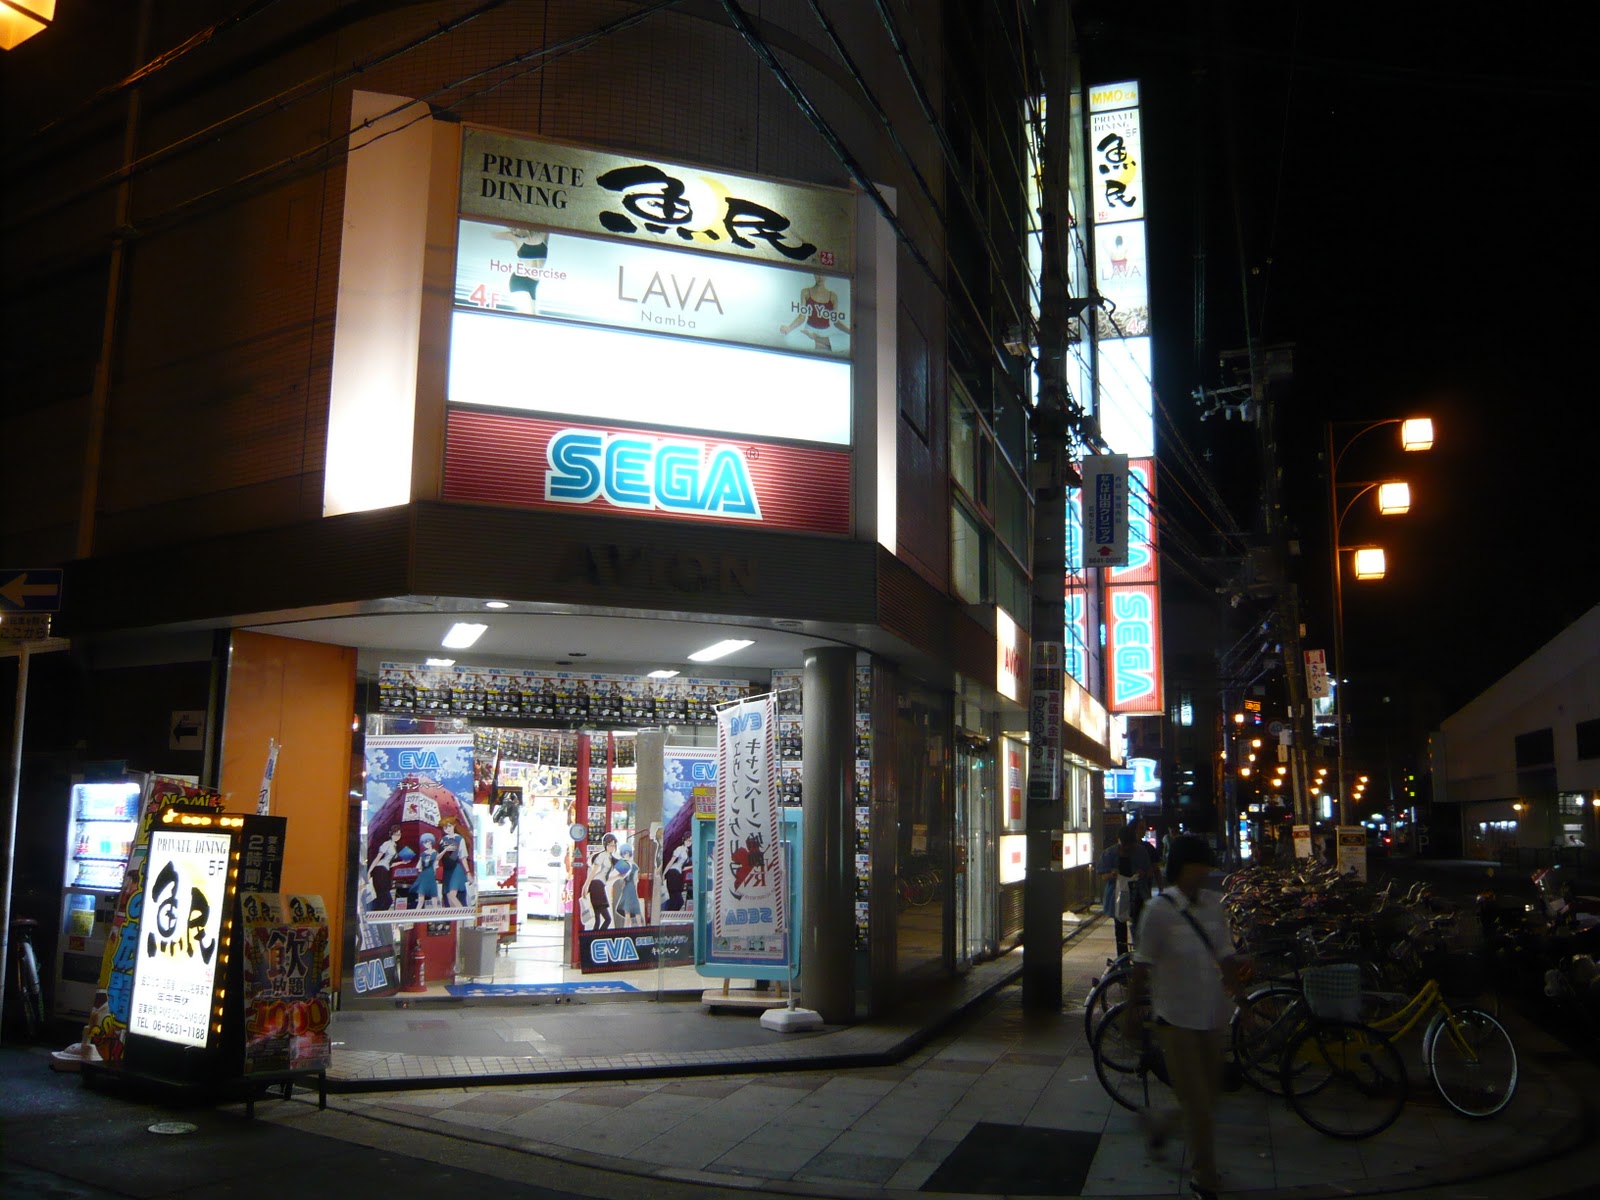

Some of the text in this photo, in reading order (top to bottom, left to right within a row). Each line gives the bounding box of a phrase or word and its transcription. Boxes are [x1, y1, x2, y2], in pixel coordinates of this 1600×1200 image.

[1094, 112, 1135, 124] PRIVATE
[1094, 121, 1130, 132] DINING
[1125, 127, 1138, 138] 5F
[482, 152, 584, 188] PRIVATE
[1096, 133, 1137, 208] 魚民
[481, 177, 568, 210] DINING
[597, 164, 817, 261] 魚民
[490, 259, 567, 280] Hot Exercise
[1101, 264, 1142, 281] LAVA
[470, 283, 500, 308] 4F
[617, 265, 724, 316] LAVA
[641, 309, 697, 329] Namba
[791, 301, 845, 321] Hot Yoga
[1126, 319, 1147, 335] 4F
[544, 428, 763, 520] SEGA
[1099, 475, 1111, 543] なんば山田クリニック
[1112, 591, 1154, 705] SEGA
[398, 750, 441, 769] EVA
[692, 762, 717, 780] EV
[397, 781, 444, 790] キャンペーン
[157, 837, 227, 855] PRIVATE DINING
[208, 860, 225, 876] 5F
[147, 861, 215, 965] 魚民
[244, 895, 275, 923] 魚民
[290, 896, 320, 923] 魚民
[591, 937, 639, 963] EVA
[354, 958, 388, 993] EVA
[137, 1016, 205, 1040] TEL 06-6631-1188
